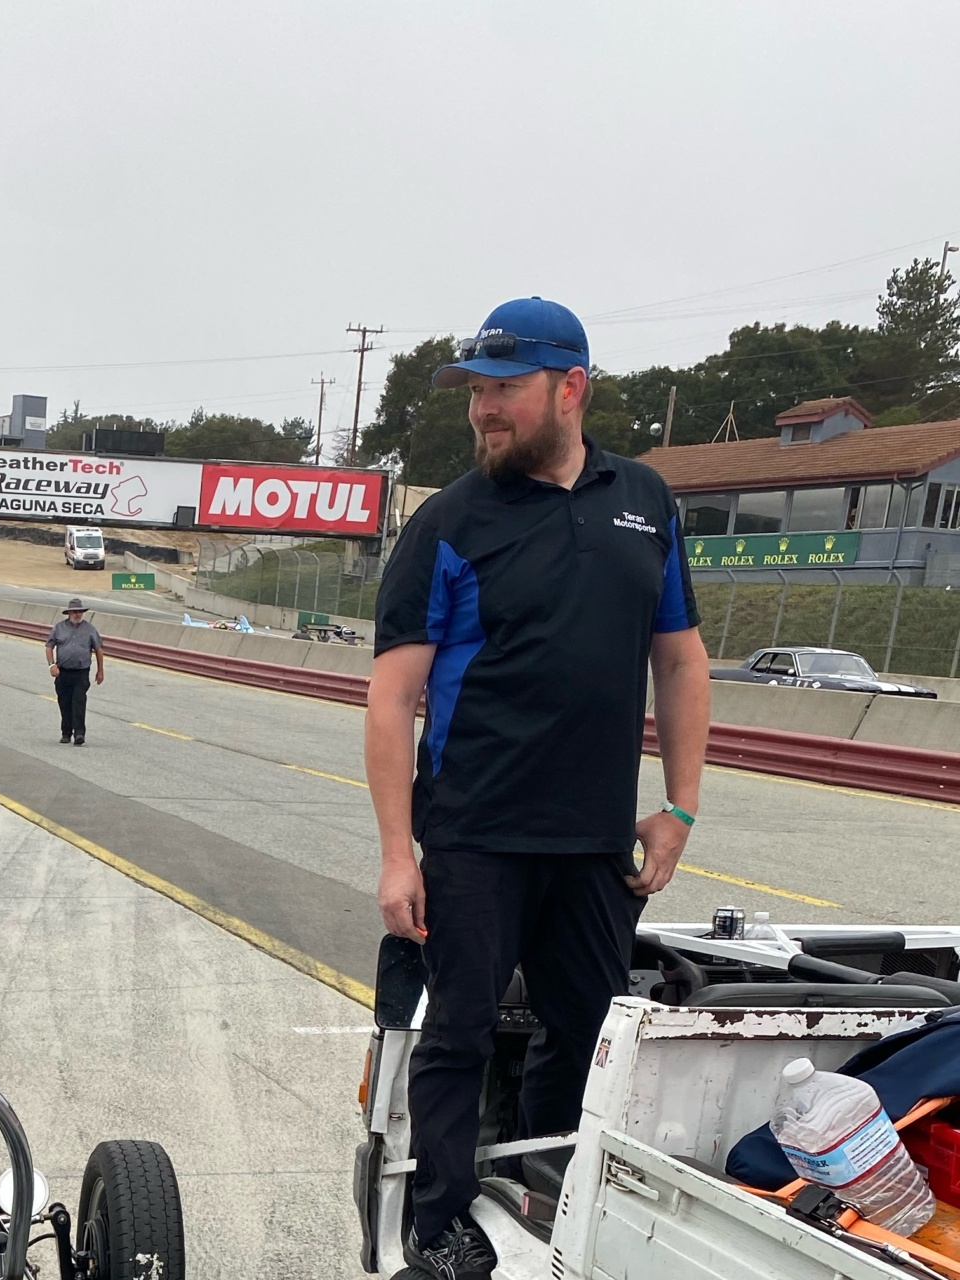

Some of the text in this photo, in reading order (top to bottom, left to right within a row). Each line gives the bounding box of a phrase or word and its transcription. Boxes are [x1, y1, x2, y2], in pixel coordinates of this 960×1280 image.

[208, 476, 371, 523] MOTUL
[61, 502, 105, 515] SECA
[622, 511, 646, 524] Teran
[613, 517, 657, 534] Motorsports
[687, 553, 845, 567] OLEX ROLEX ROLEX ROLEX
